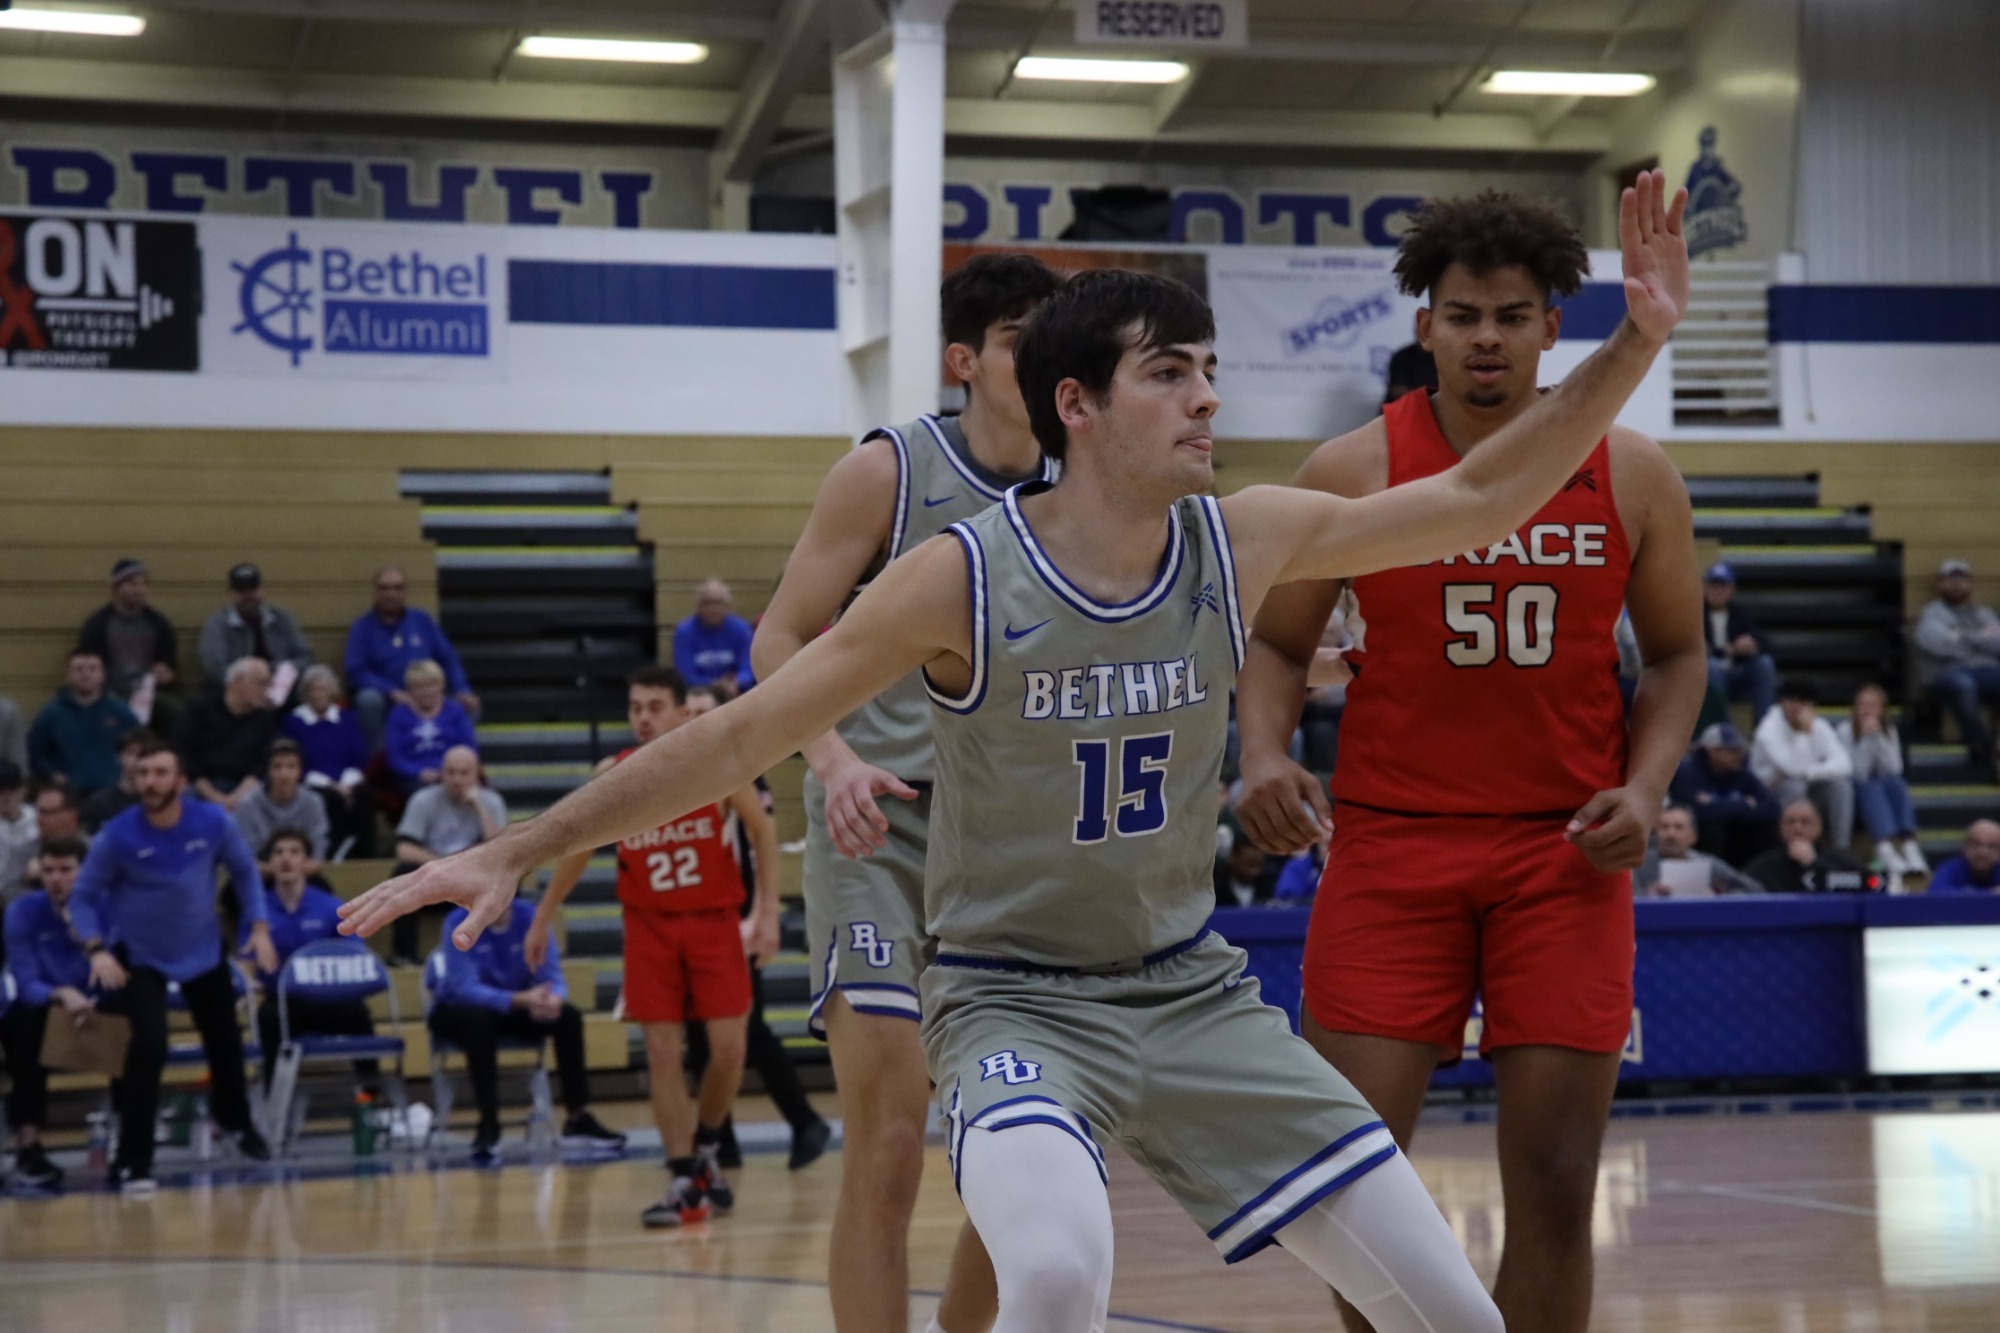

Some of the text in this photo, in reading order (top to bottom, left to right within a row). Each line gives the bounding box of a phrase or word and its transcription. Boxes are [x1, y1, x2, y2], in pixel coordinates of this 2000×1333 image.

[1097, 0, 1225, 38] RESERVED
[322, 248, 487, 298] Bethel
[327, 308, 484, 350] Alumni
[1289, 293, 1392, 352] SPORTS
[1424, 522, 1608, 567] ACE
[1443, 582, 1560, 668] 50
[1022, 654, 1209, 720] BETHEL
[1072, 730, 1175, 845] 15
[645, 846, 703, 893] 22
[848, 921, 894, 969] BU
[978, 1049, 1043, 1086] BU
